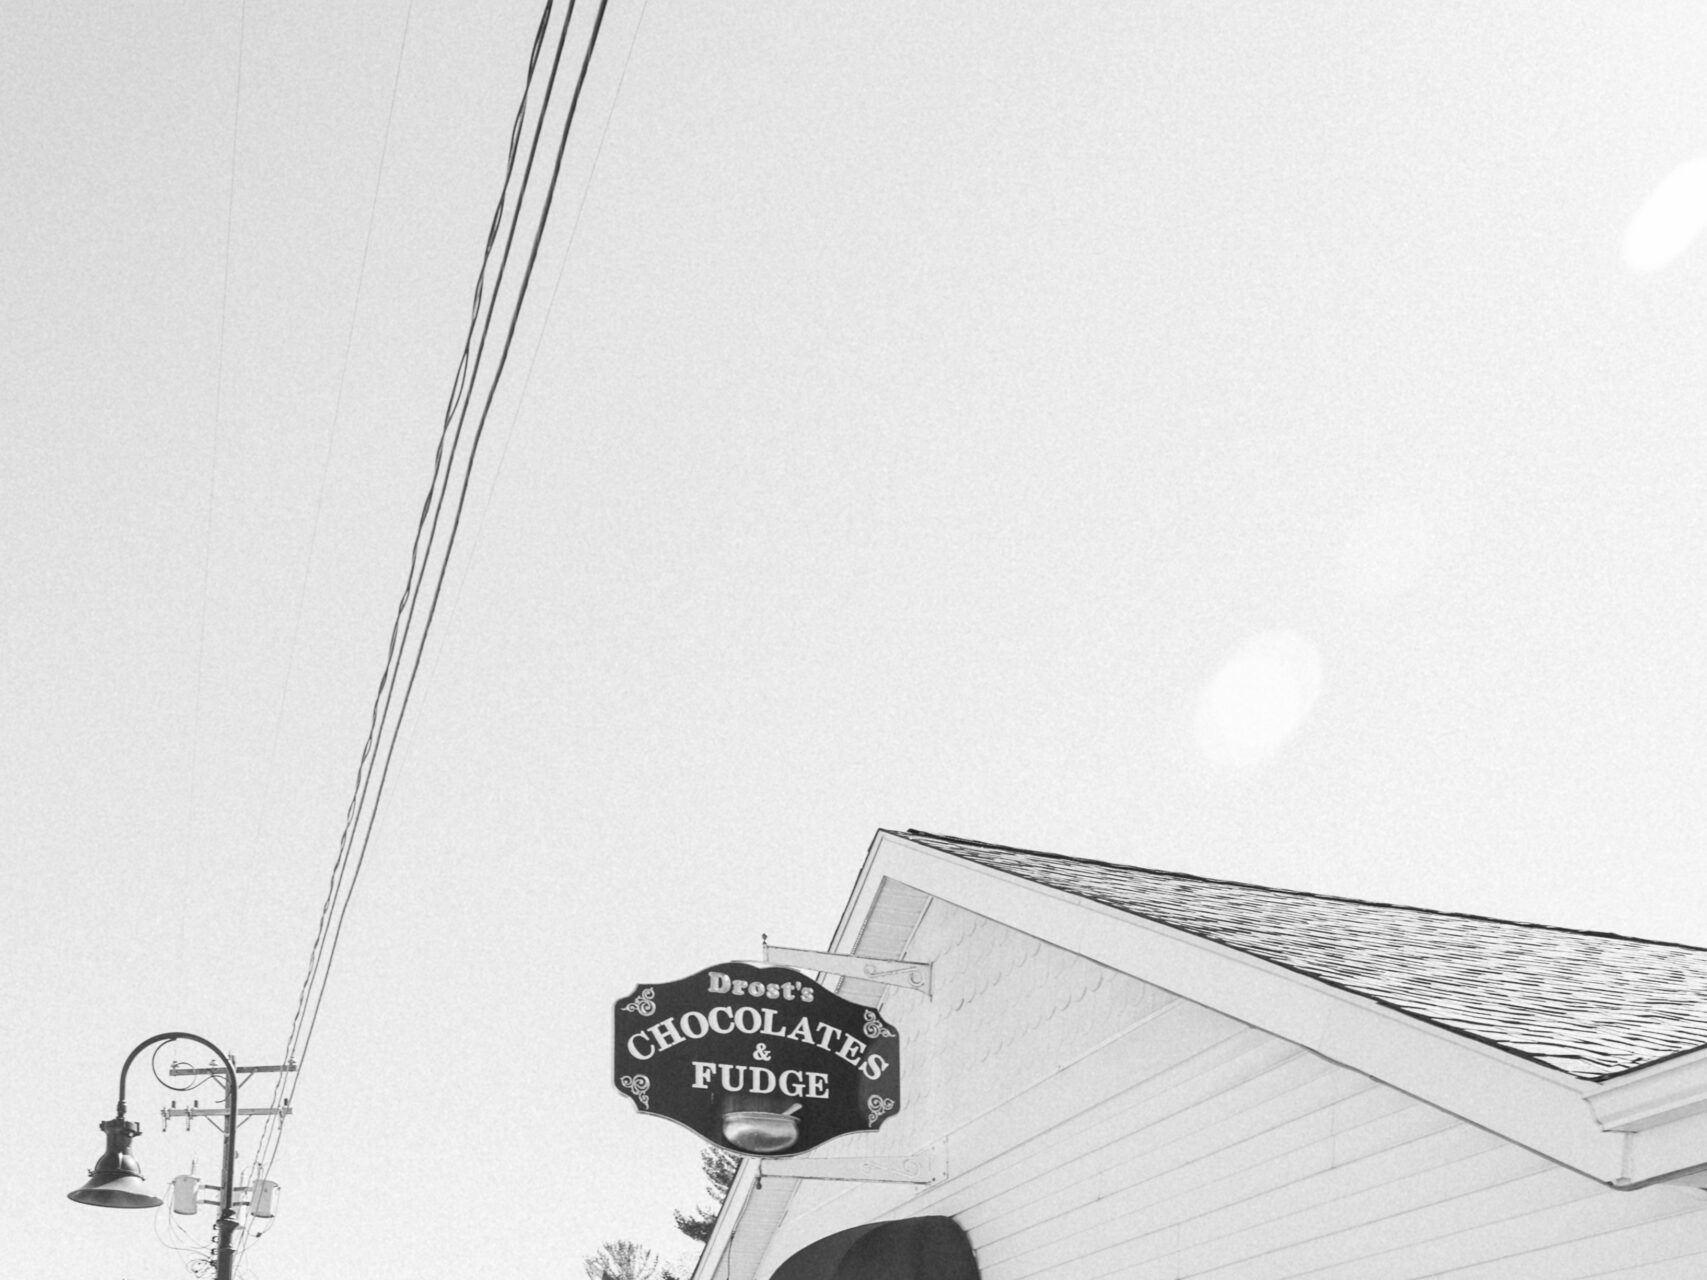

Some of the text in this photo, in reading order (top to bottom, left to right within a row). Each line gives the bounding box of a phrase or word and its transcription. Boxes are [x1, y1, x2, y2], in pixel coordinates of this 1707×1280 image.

[707, 971, 815, 1003] Drost's
[627, 1006, 889, 1080] CHOCOLATES
[752, 1042, 772, 1062] &
[691, 1061, 830, 1099] FUDGE
